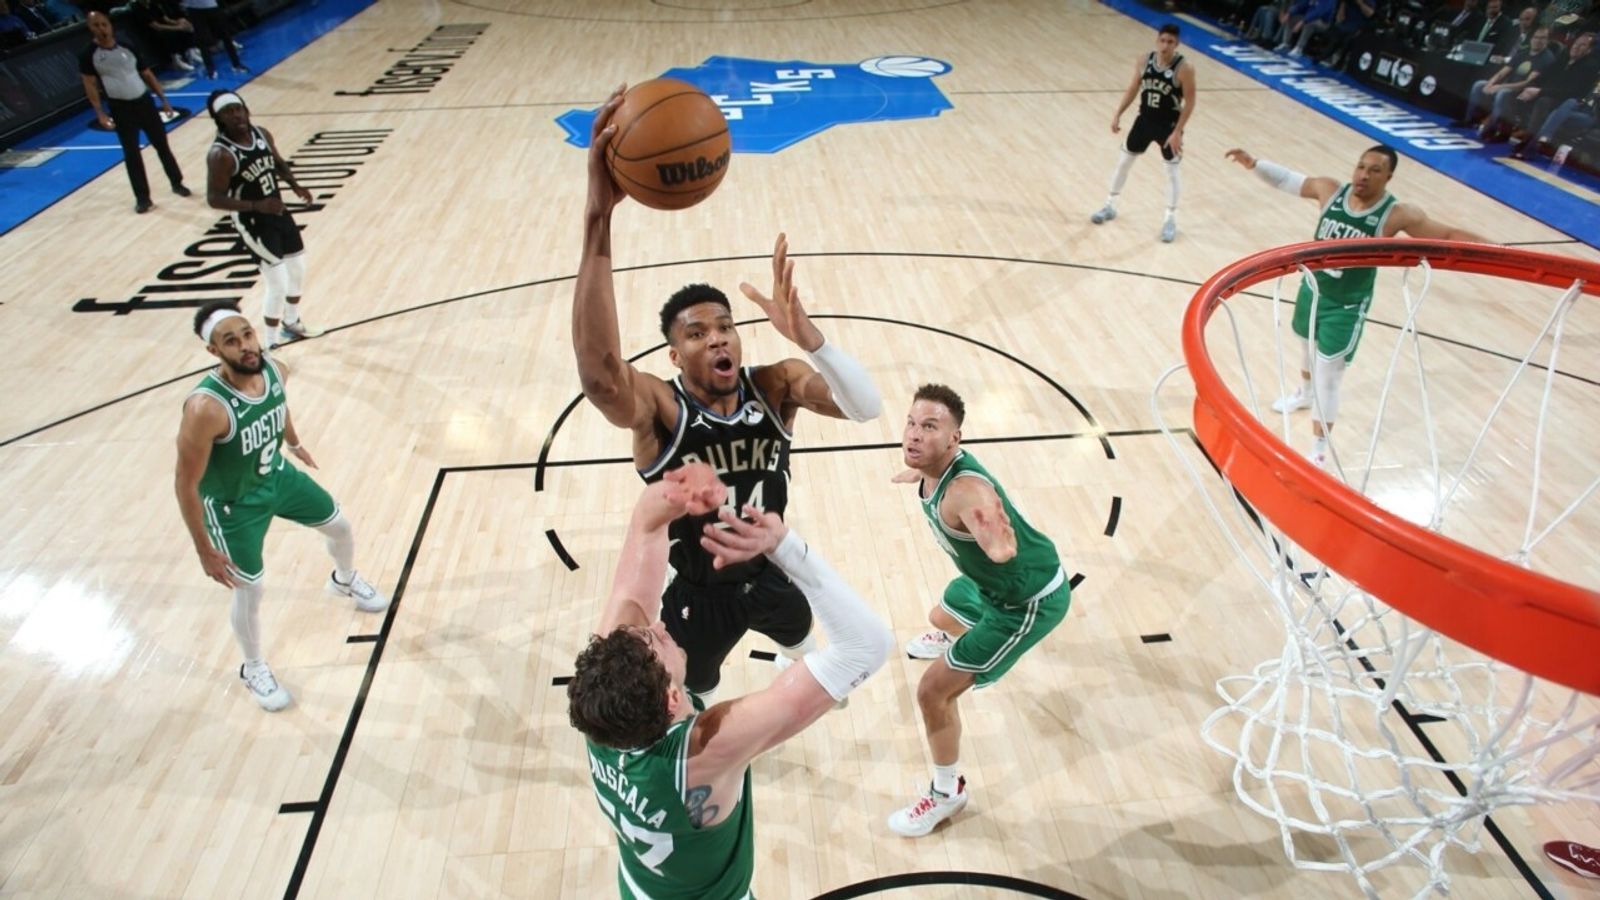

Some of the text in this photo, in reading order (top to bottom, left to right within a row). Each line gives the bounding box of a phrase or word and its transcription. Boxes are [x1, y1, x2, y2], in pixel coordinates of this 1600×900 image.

[710, 69, 836, 120] CKS
[1147, 91, 1161, 108] 12
[656, 147, 730, 186] Wilson
[259, 172, 276, 196] 21
[1318, 217, 1371, 239] BOSTO
[258, 438, 278, 475] 9
